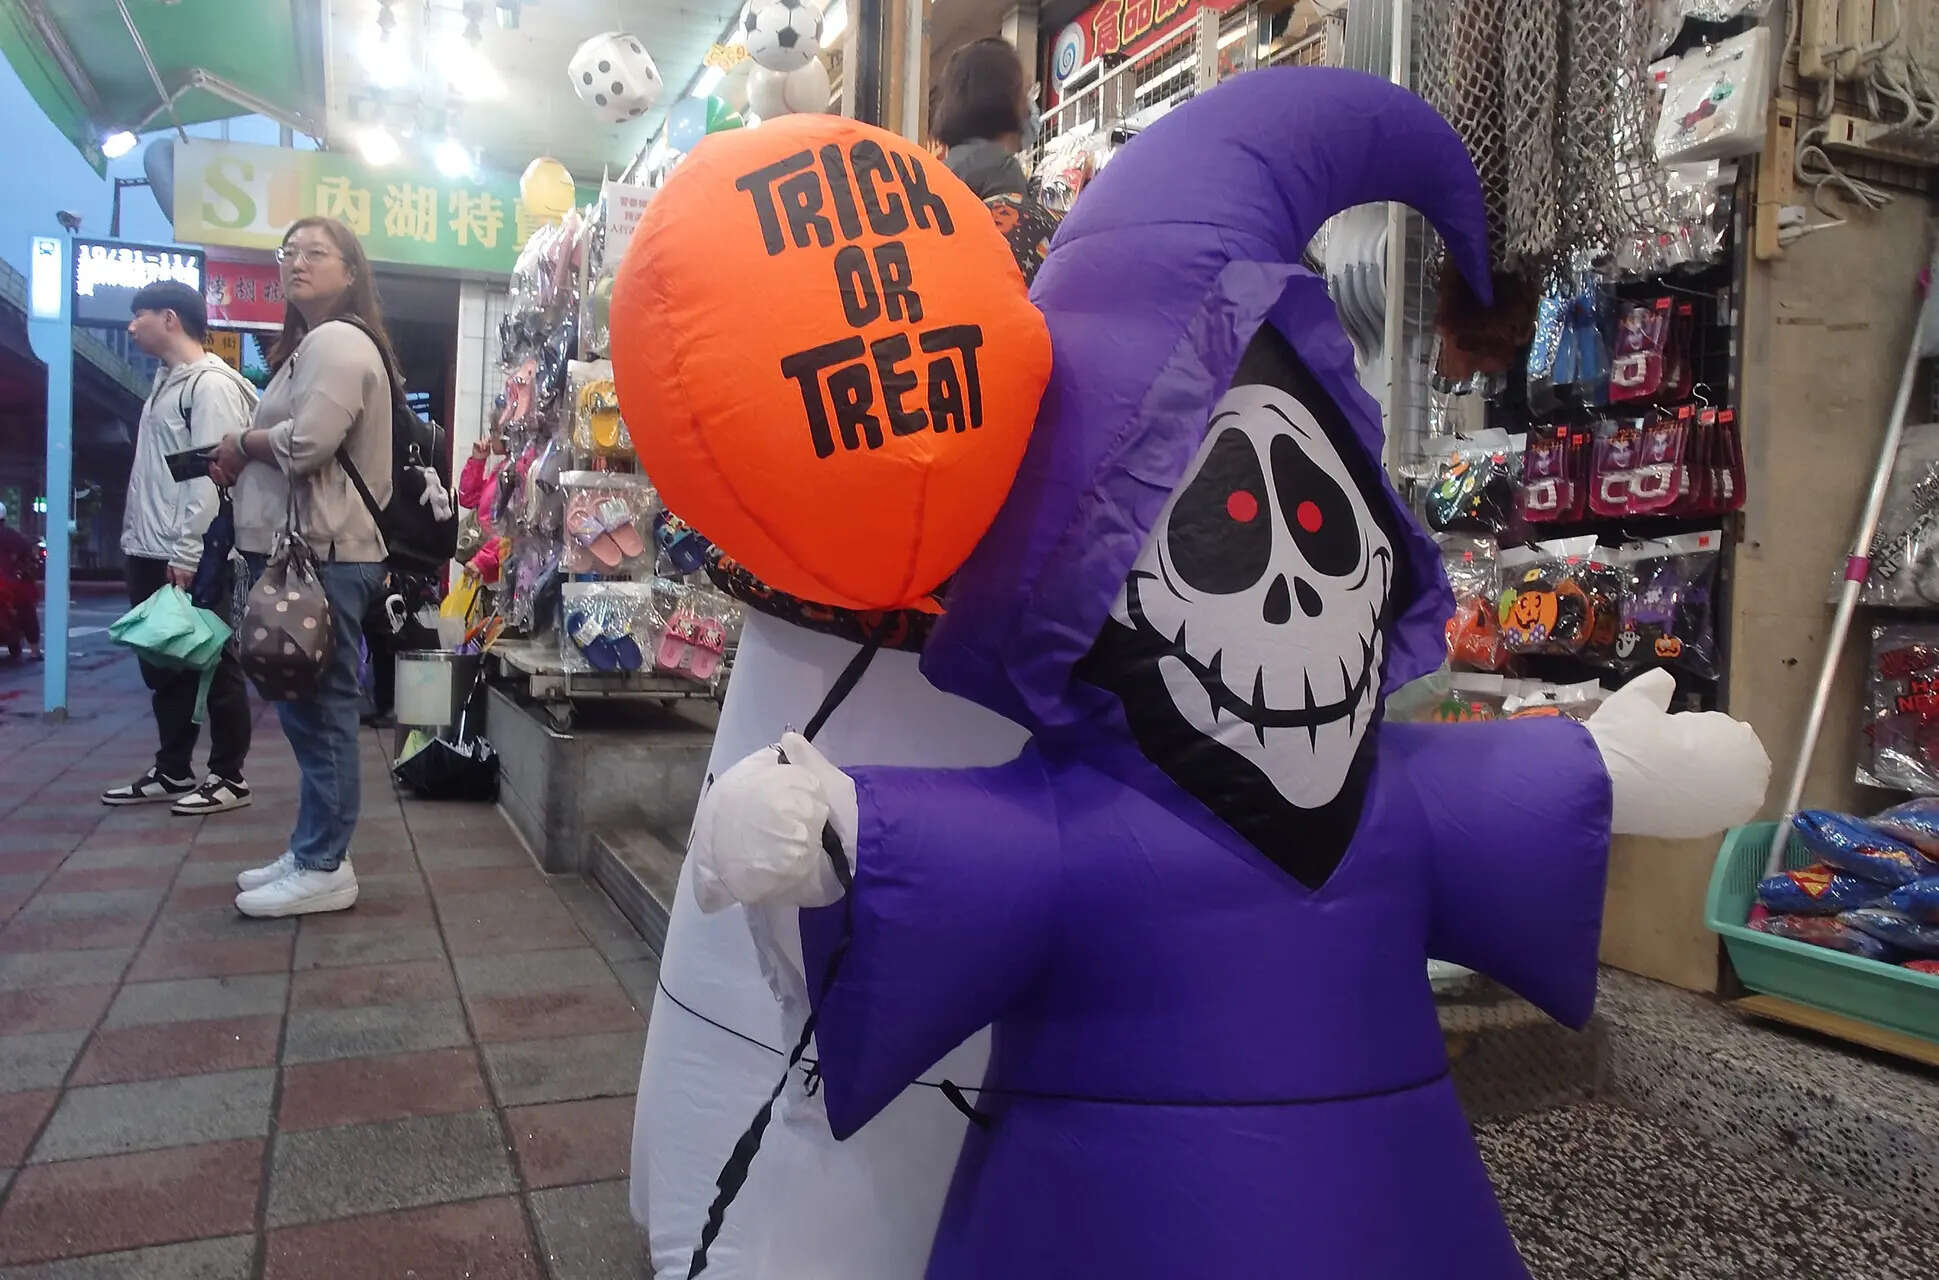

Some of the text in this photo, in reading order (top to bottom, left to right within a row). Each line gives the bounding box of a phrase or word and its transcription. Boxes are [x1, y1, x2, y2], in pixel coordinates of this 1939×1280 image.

[735, 139, 955, 256] TRICK
[834, 241, 923, 328] OR
[780, 324, 983, 459] TREAT
